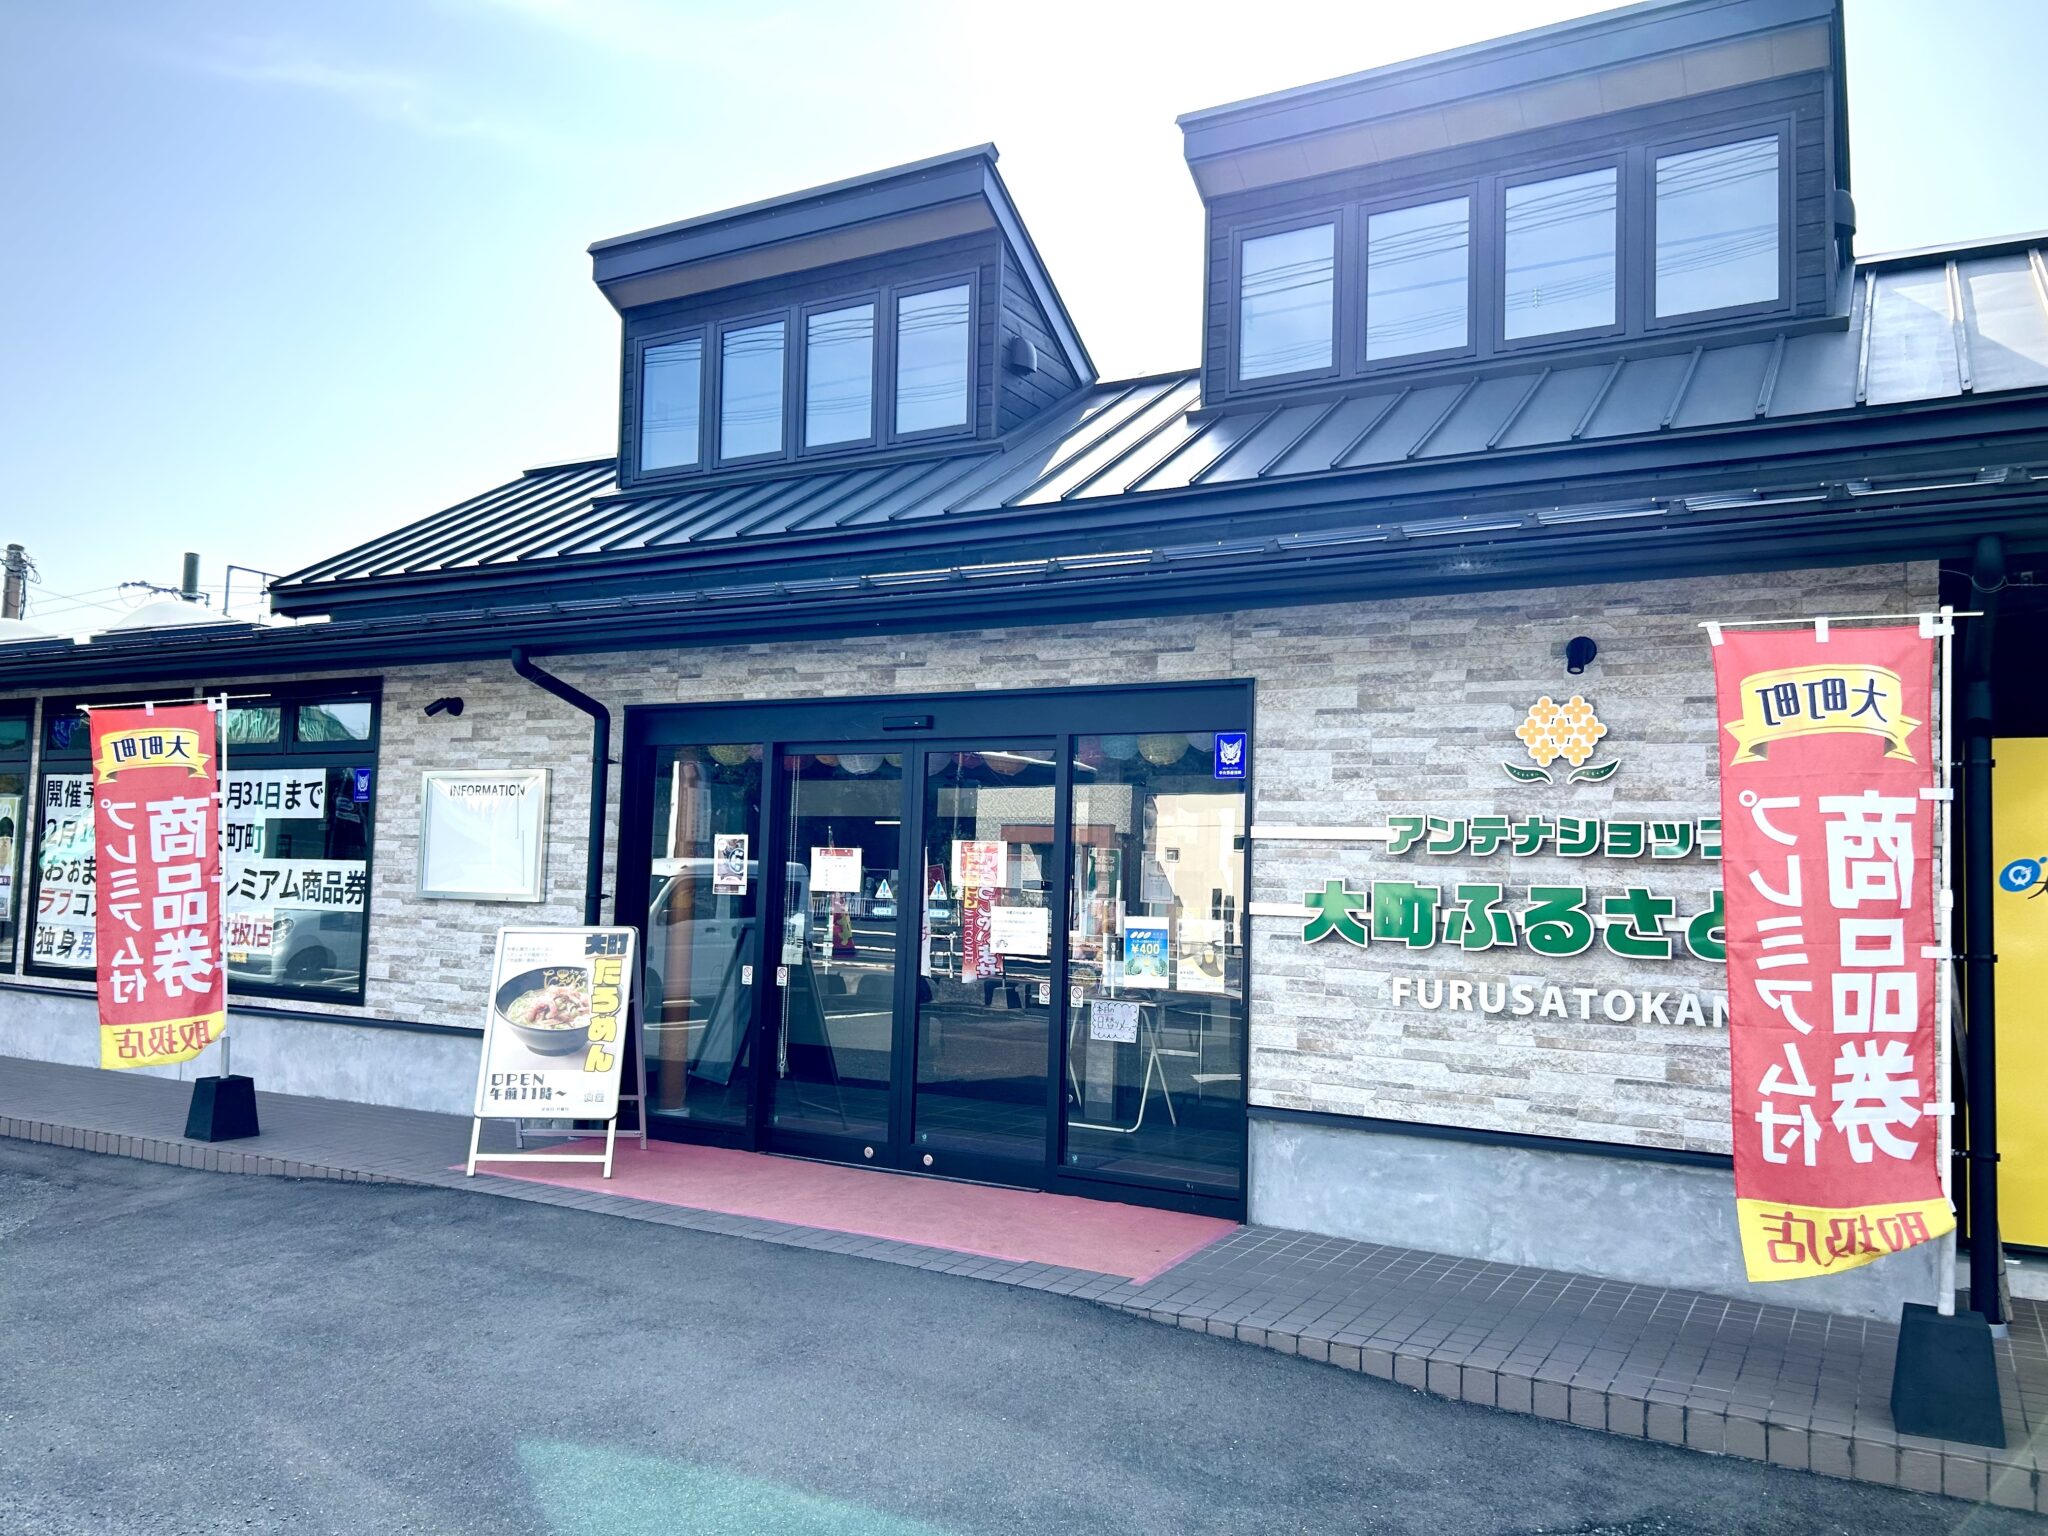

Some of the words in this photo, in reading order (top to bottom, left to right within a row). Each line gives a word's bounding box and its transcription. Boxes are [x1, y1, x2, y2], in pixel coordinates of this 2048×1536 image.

[450, 784, 526, 797] INFORMATION
[218, 823, 265, 853] 町町
[219, 914, 272, 948] 扱店
[585, 933, 629, 955] 大町
[491, 1073, 545, 1086] OPEN
